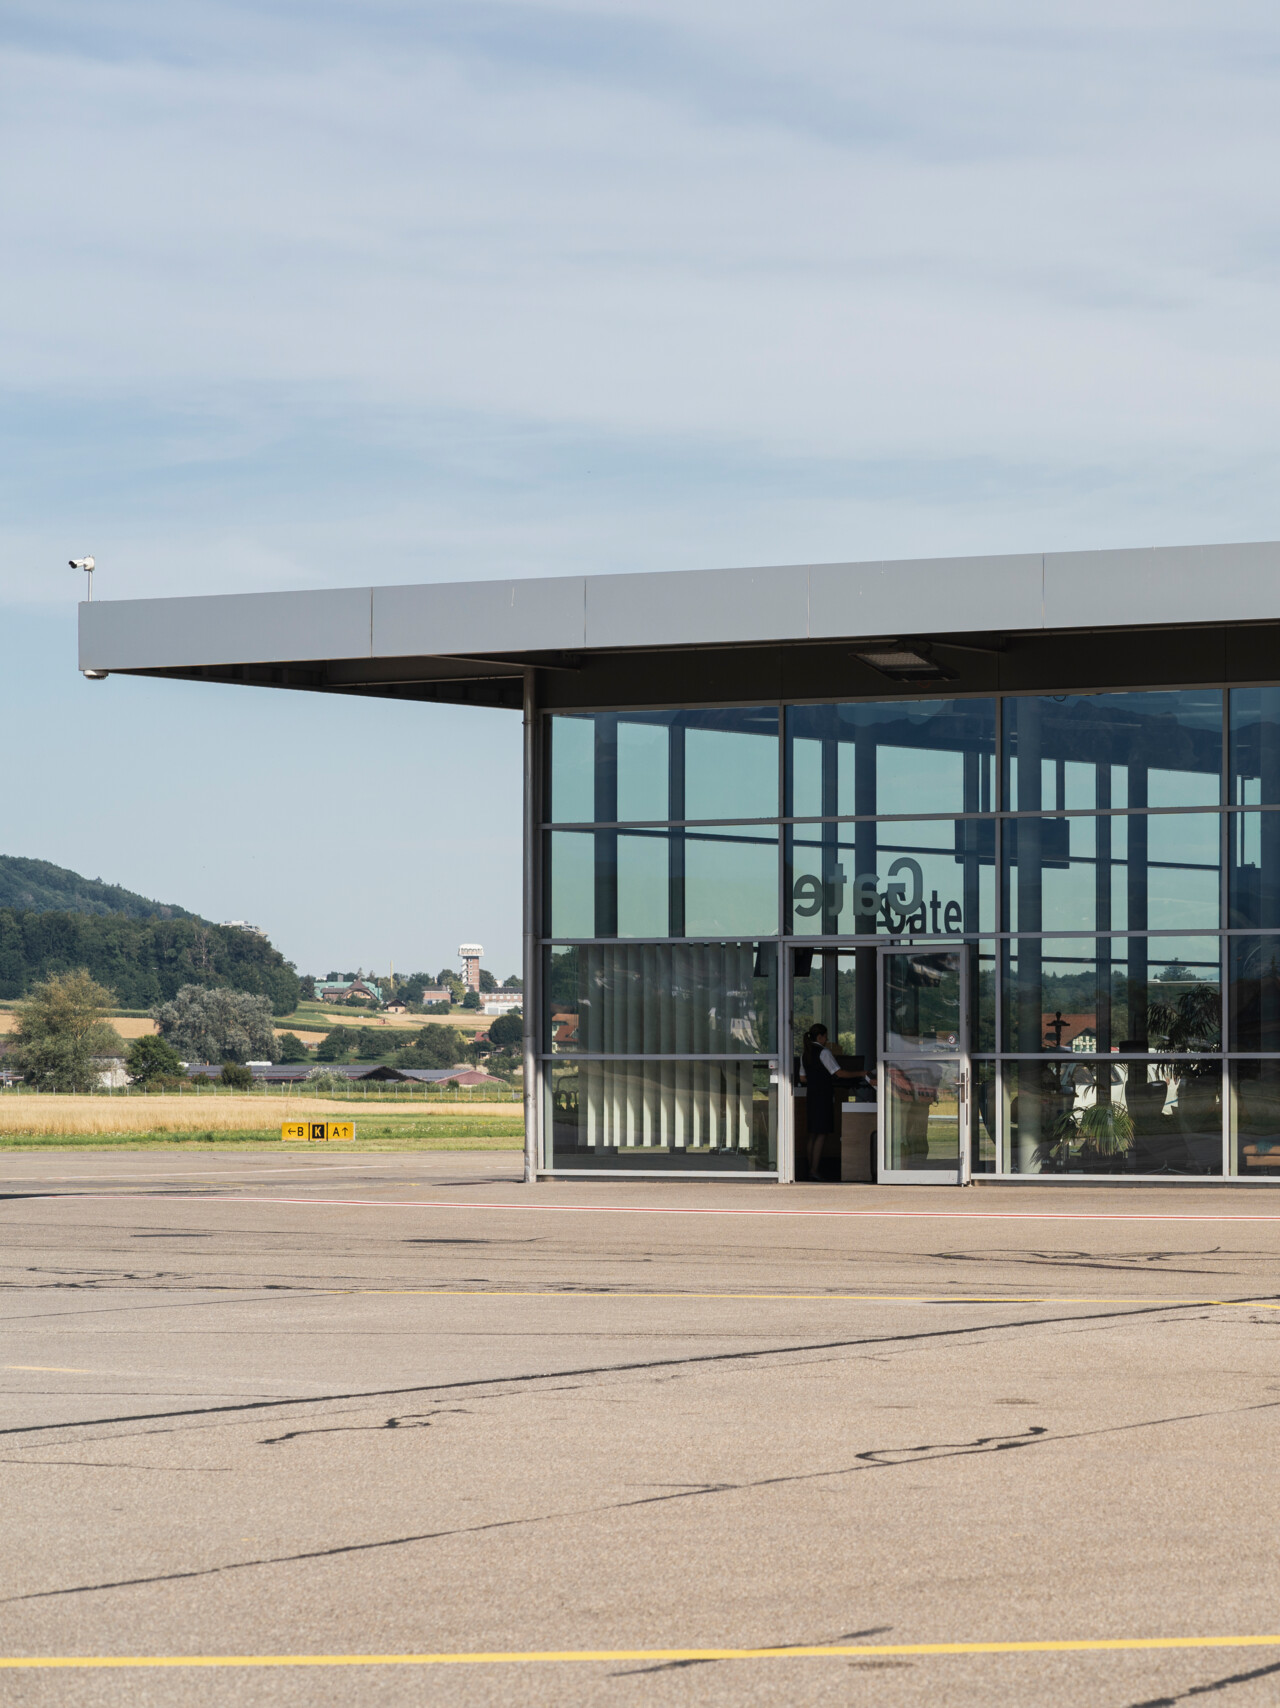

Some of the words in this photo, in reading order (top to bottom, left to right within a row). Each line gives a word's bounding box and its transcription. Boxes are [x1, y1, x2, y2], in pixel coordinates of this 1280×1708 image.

[297, 1126, 304, 1137] B
[314, 1126, 322, 1137] K
[333, 1126, 340, 1137] A
